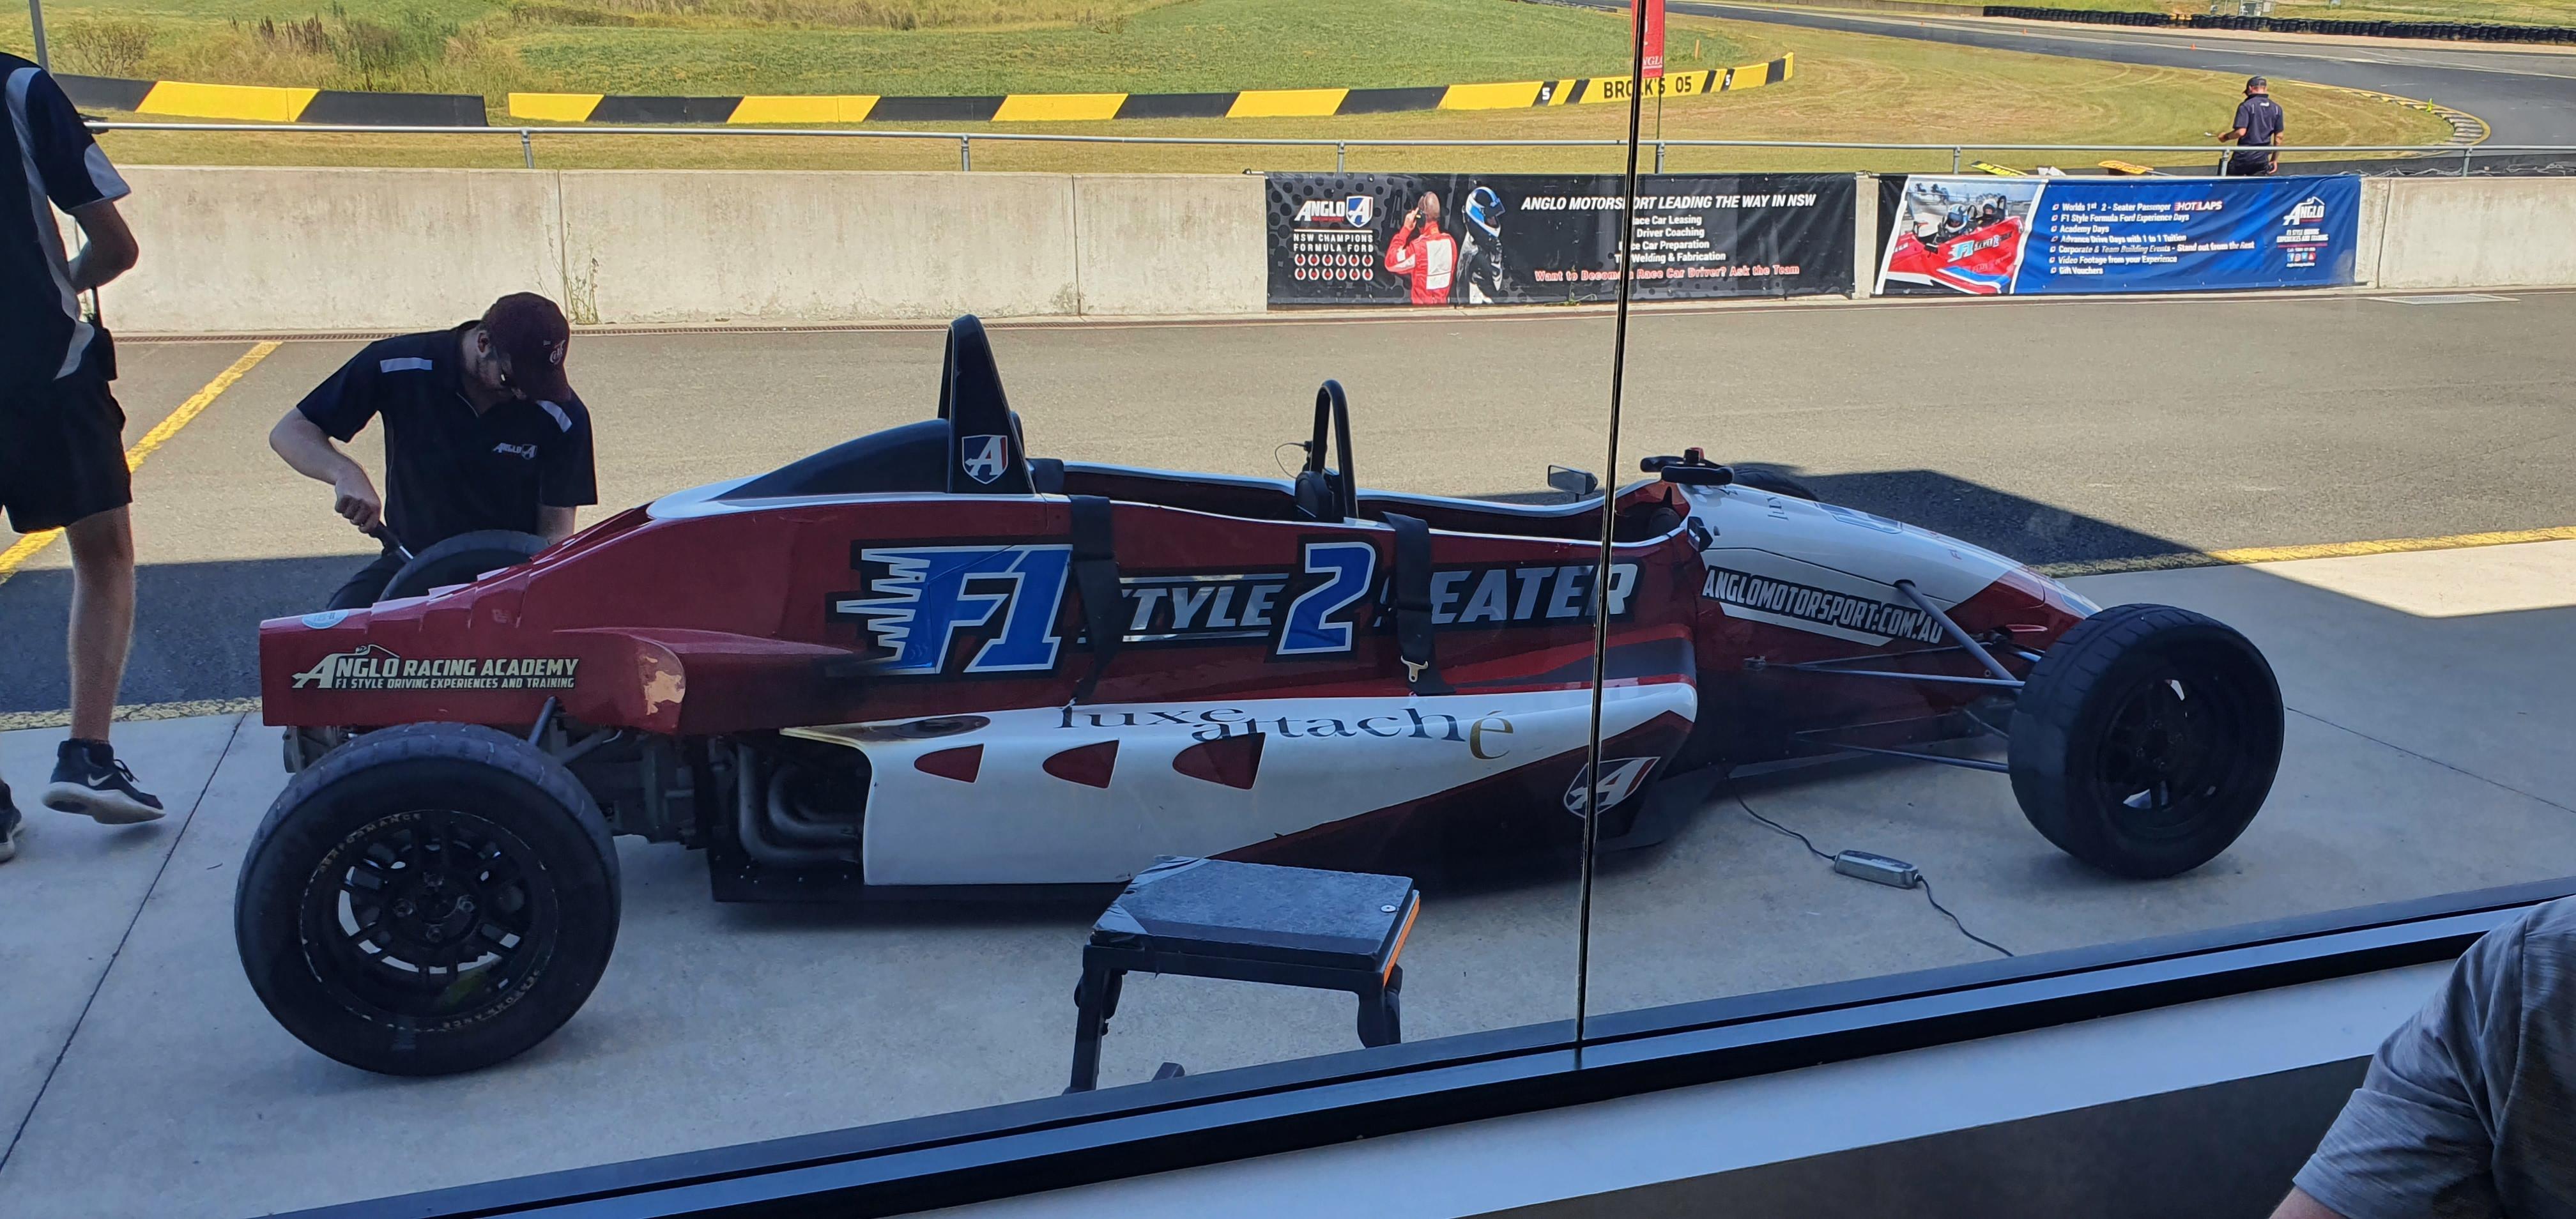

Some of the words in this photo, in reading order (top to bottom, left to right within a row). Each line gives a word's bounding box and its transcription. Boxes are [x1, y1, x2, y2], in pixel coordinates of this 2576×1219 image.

[1604, 77, 1666, 98] BROK'S
[1521, 197, 1567, 210] ANGLO
[1658, 196, 1713, 210] LEADING
[1715, 195, 1740, 208] THE
[1742, 195, 1770, 208] WAY
[1772, 195, 1786, 207] IN
[1787, 194, 1817, 207] NSW
[1294, 201, 1346, 221] ANGLO
[2062, 203, 2085, 211] Worlds
[2112, 203, 2136, 211] Seater
[2137, 203, 2172, 213] Passenger
[1652, 215, 1667, 225] Car
[1669, 215, 1702, 226] Leasing
[2071, 214, 2089, 224] Style
[2090, 214, 2119, 222] Formula
[2119, 213, 2136, 222] Ford
[2136, 213, 2173, 224] Experience
[2173, 213, 2189, 223] Days
[1637, 228, 1664, 238] Driver
[1665, 227, 1705, 238] Coaching
[2059, 225, 2092, 234] Academy
[2092, 225, 2110, 234] Days
[1294, 234, 1314, 242] NSW
[1318, 234, 1373, 243] CHAMPIONS
[1294, 244, 1342, 252] FORMULA
[1347, 244, 1373, 252] FORD
[1642, 241, 1659, 250] Car
[1660, 240, 1710, 251] Preparation
[1631, 253, 1666, 264] Welding
[1668, 253, 1675, 262] &
[1677, 251, 1726, 263] Fabrication
[2079, 256, 2107, 266] Footage
[2142, 255, 2178, 264] Experience
[1535, 270, 1563, 282] Want
[1566, 270, 1578, 281] to
[1636, 268, 1664, 280] Race
[1666, 268, 1685, 279] Car
[1688, 266, 1727, 279] Driver?
[1729, 265, 1751, 277] Ask
[1752, 264, 1770, 276] the
[1773, 264, 1800, 276] Team
[836, 544, 1073, 675] F1
[1121, 584, 1285, 631] TYLE
[1276, 542, 1376, 655] 2
[291, 652, 400, 688] ANGLO
[403, 659, 477, 677] RACING
[480, 659, 579, 676] ACADEMY
[335, 678, 347, 689] F1
[351, 678, 383, 689] STYLE
[387, 678, 429, 689] DRIVING
[430, 678, 498, 689] EXPERIENCES
[501, 678, 523, 688] AND
[526, 677, 574, 688] TRAINING
[1054, 705, 1245, 728] luxe
